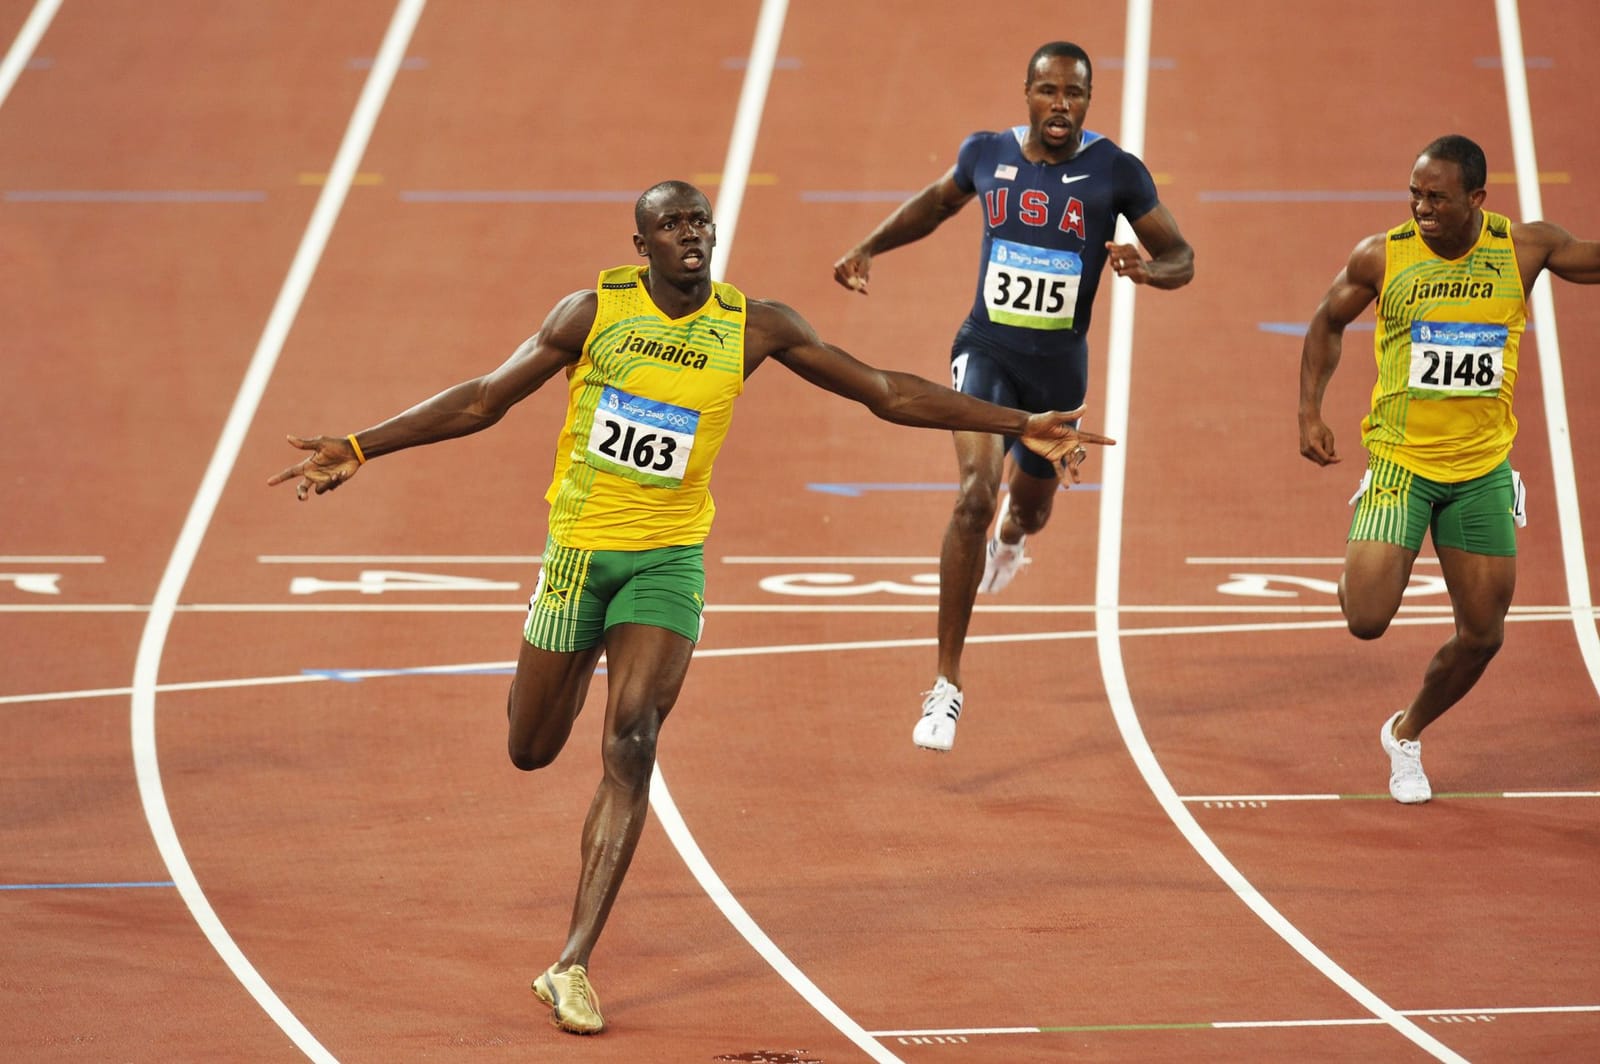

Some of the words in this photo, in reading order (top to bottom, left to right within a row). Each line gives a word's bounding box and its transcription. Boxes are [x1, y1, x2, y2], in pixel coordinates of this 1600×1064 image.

[985, 187, 1086, 240] USA
[993, 272, 1066, 313] 3215
[1405, 277, 1493, 305] jamaica
[616, 330, 708, 370] jamaica
[1421, 350, 1495, 386] 2148
[598, 420, 677, 471] 2163
